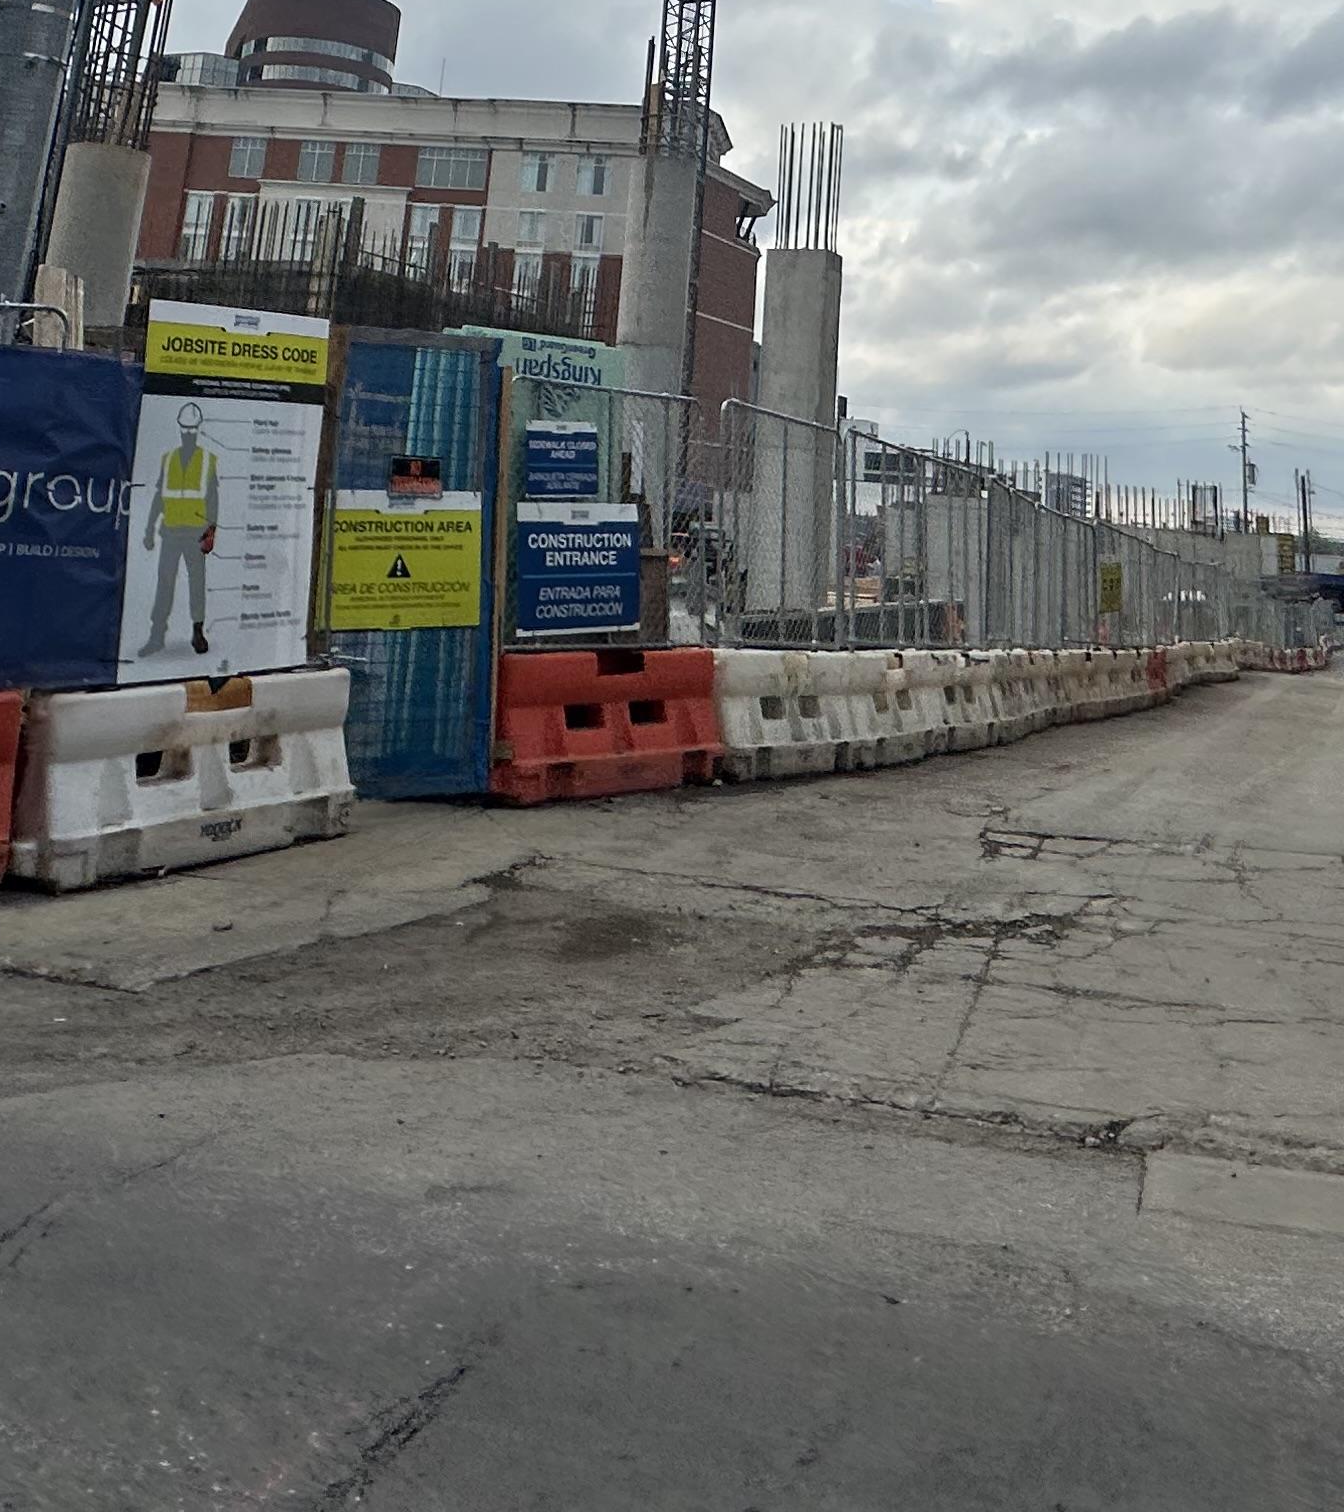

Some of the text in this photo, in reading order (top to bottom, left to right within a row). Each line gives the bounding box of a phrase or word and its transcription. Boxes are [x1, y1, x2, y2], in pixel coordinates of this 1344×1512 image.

[161, 336, 318, 364] JOBSITE DRESS CODE
[436, 520, 473, 533] AREA
[527, 533, 632, 549] CONSTRUCTION
[544, 550, 618, 567] ENTRANCE
[538, 584, 622, 601] ENTRADA PARA
